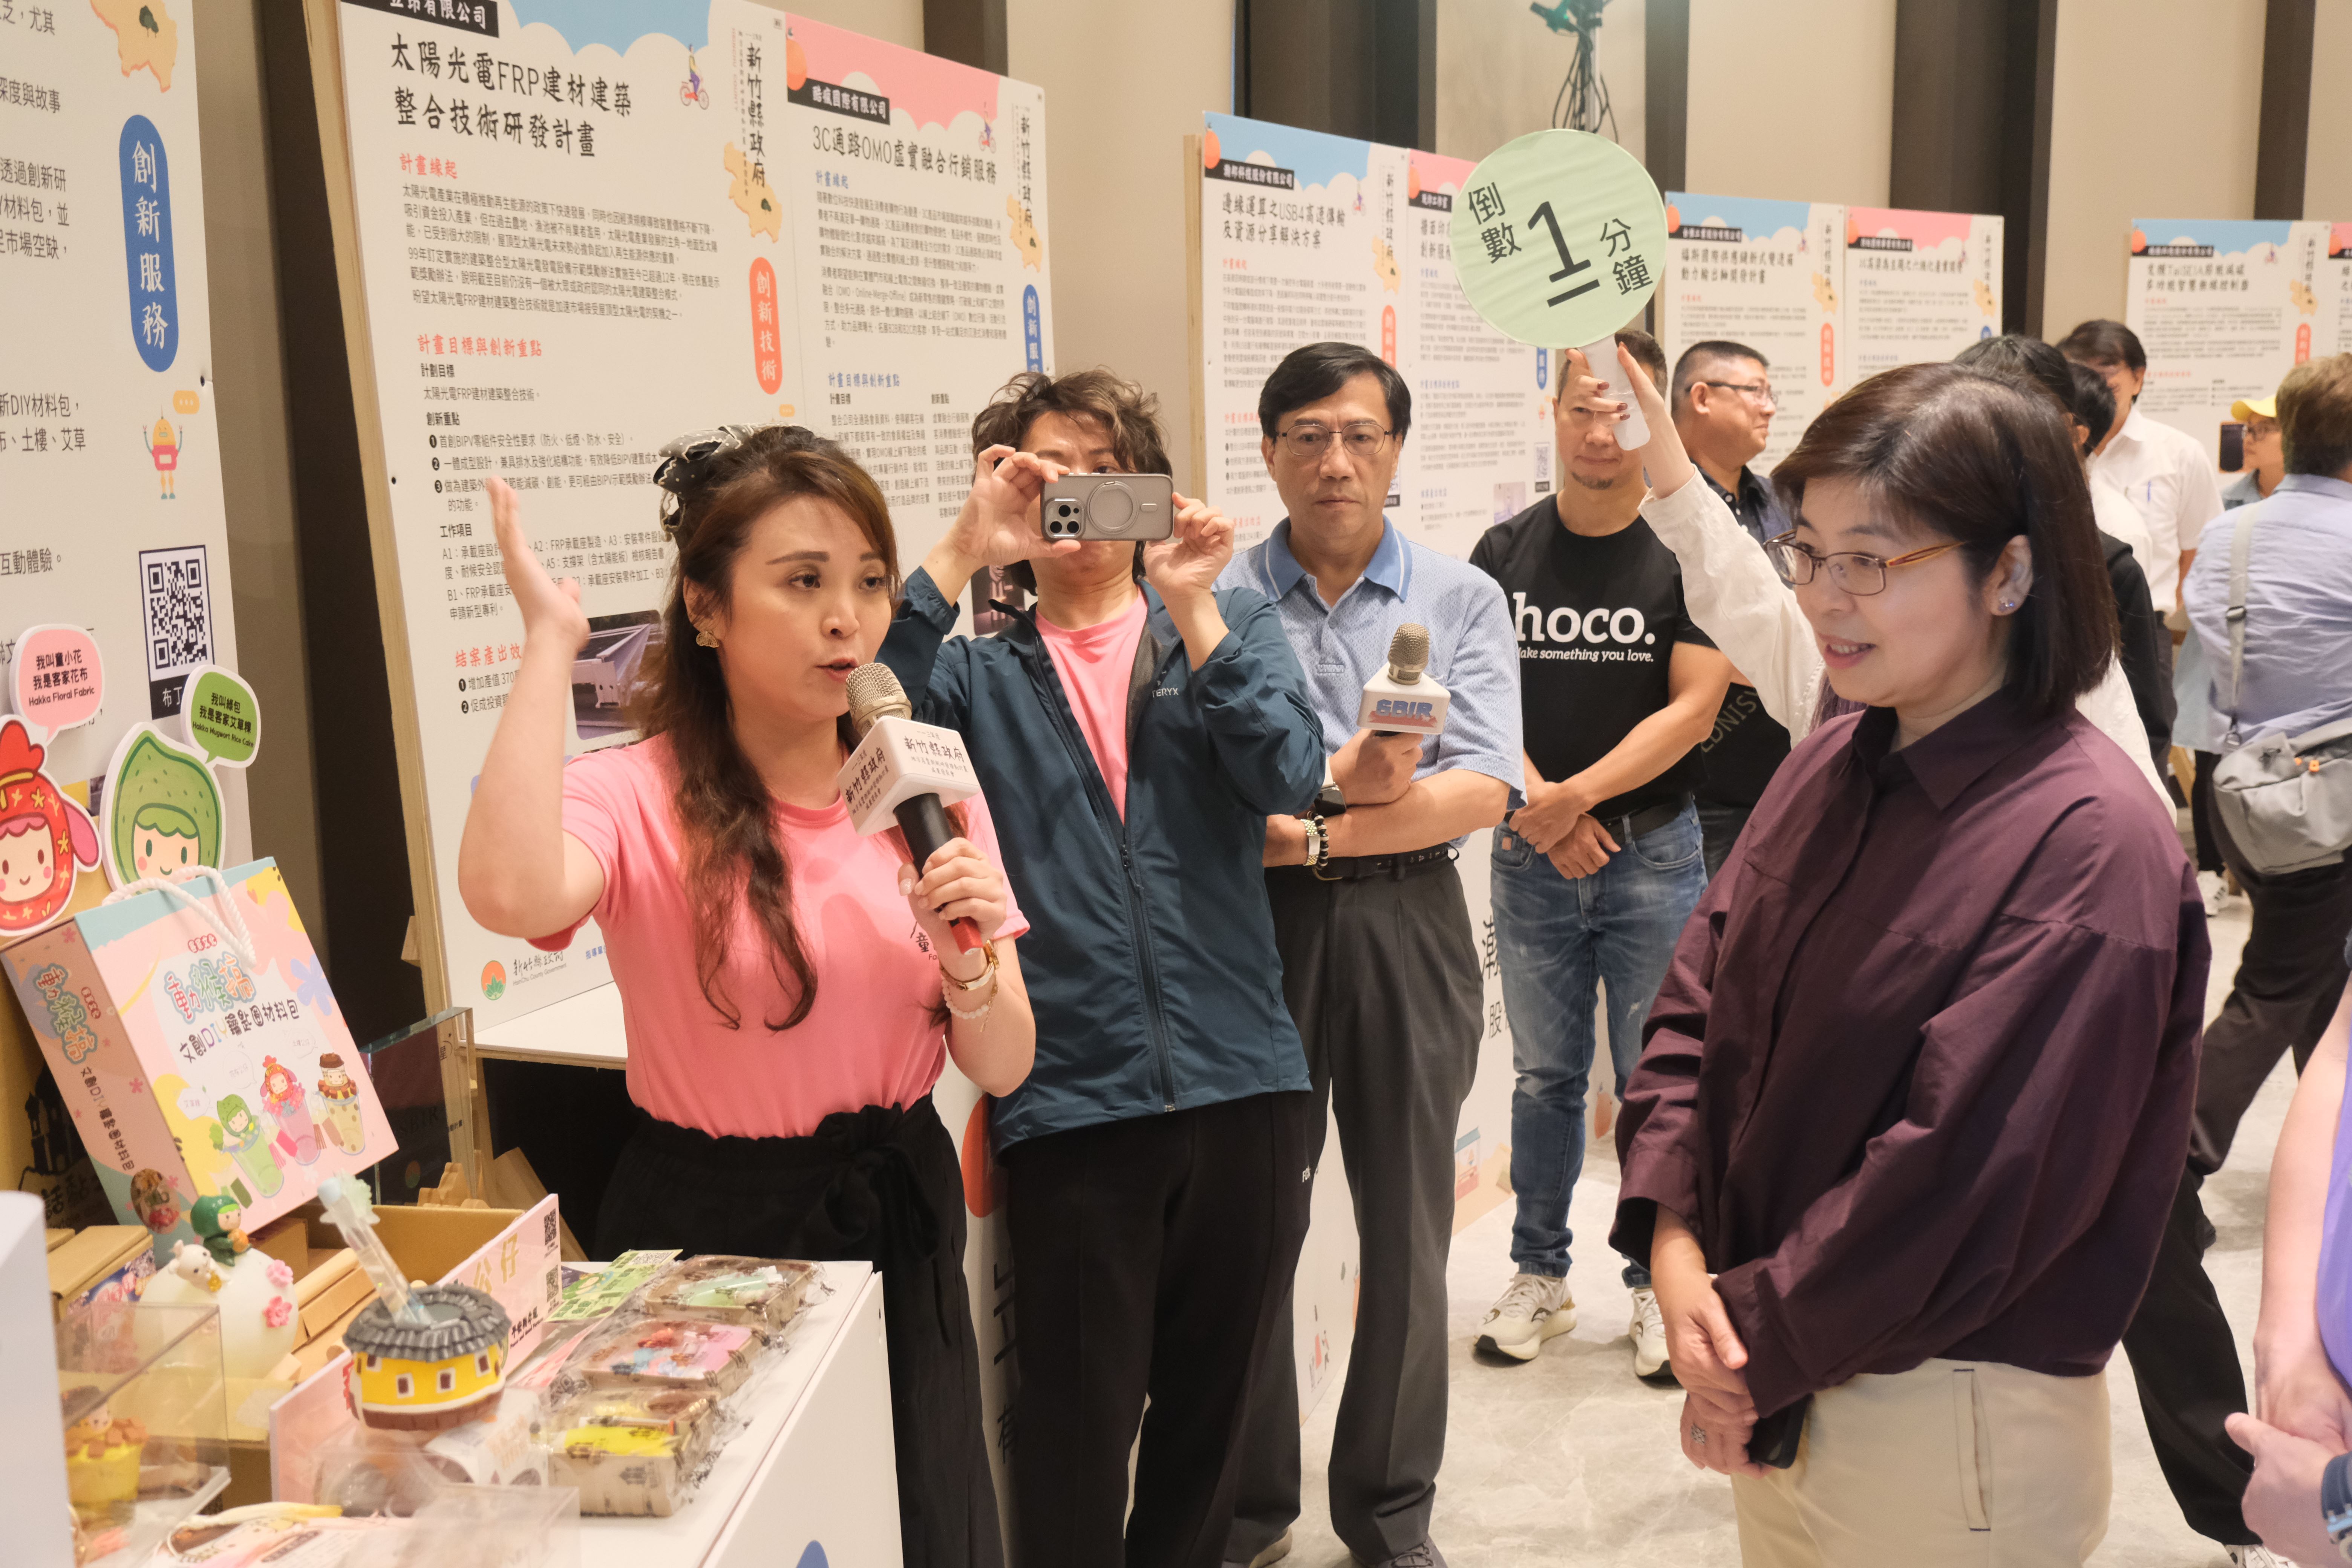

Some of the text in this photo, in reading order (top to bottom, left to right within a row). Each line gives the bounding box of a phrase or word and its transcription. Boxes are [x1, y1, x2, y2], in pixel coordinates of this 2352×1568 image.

[390, 0, 486, 29] 有限公司
[391, 33, 631, 116] 太陽光電FRP建材建築
[394, 86, 595, 157] 整合技術研發計畫
[746, 43, 766, 188] 新竹縣政府
[400, 153, 458, 179] 計畫緣起
[813, 126, 997, 185] 3C通路OMO虛實融合行銷服務
[1223, 221, 1321, 249] 及資源分享解決方案
[1468, 182, 1521, 264] 倒數
[132, 140, 168, 349] 創新服務
[1528, 201, 1591, 283] 1
[1600, 218, 1653, 295] 分鐘
[756, 271, 777, 381] 創新技術
[417, 333, 542, 358] 計畫目標與創新重點
[427, 412, 460, 426] 創新重點
[440, 523, 472, 538] 工作項目
[1513, 592, 1655, 645] hoco.
[37, 648, 82, 670] 我叫童小花
[455, 643, 522, 668] 結案產出效
[1518, 647, 1654, 662] ake something you love.
[33, 668, 88, 691] 我是客家花布
[29, 686, 95, 707] Hakka Floral Fabric
[211, 692, 240, 714] 我叫綠包
[199, 705, 251, 733] 我是客家艾草粿
[193, 721, 208, 732] Hakka
[231, 733, 241, 743] Rice
[242, 738, 254, 747] Cake
[904, 736, 965, 763] 新竹縣政府
[845, 747, 885, 804] 新竹縣政府
